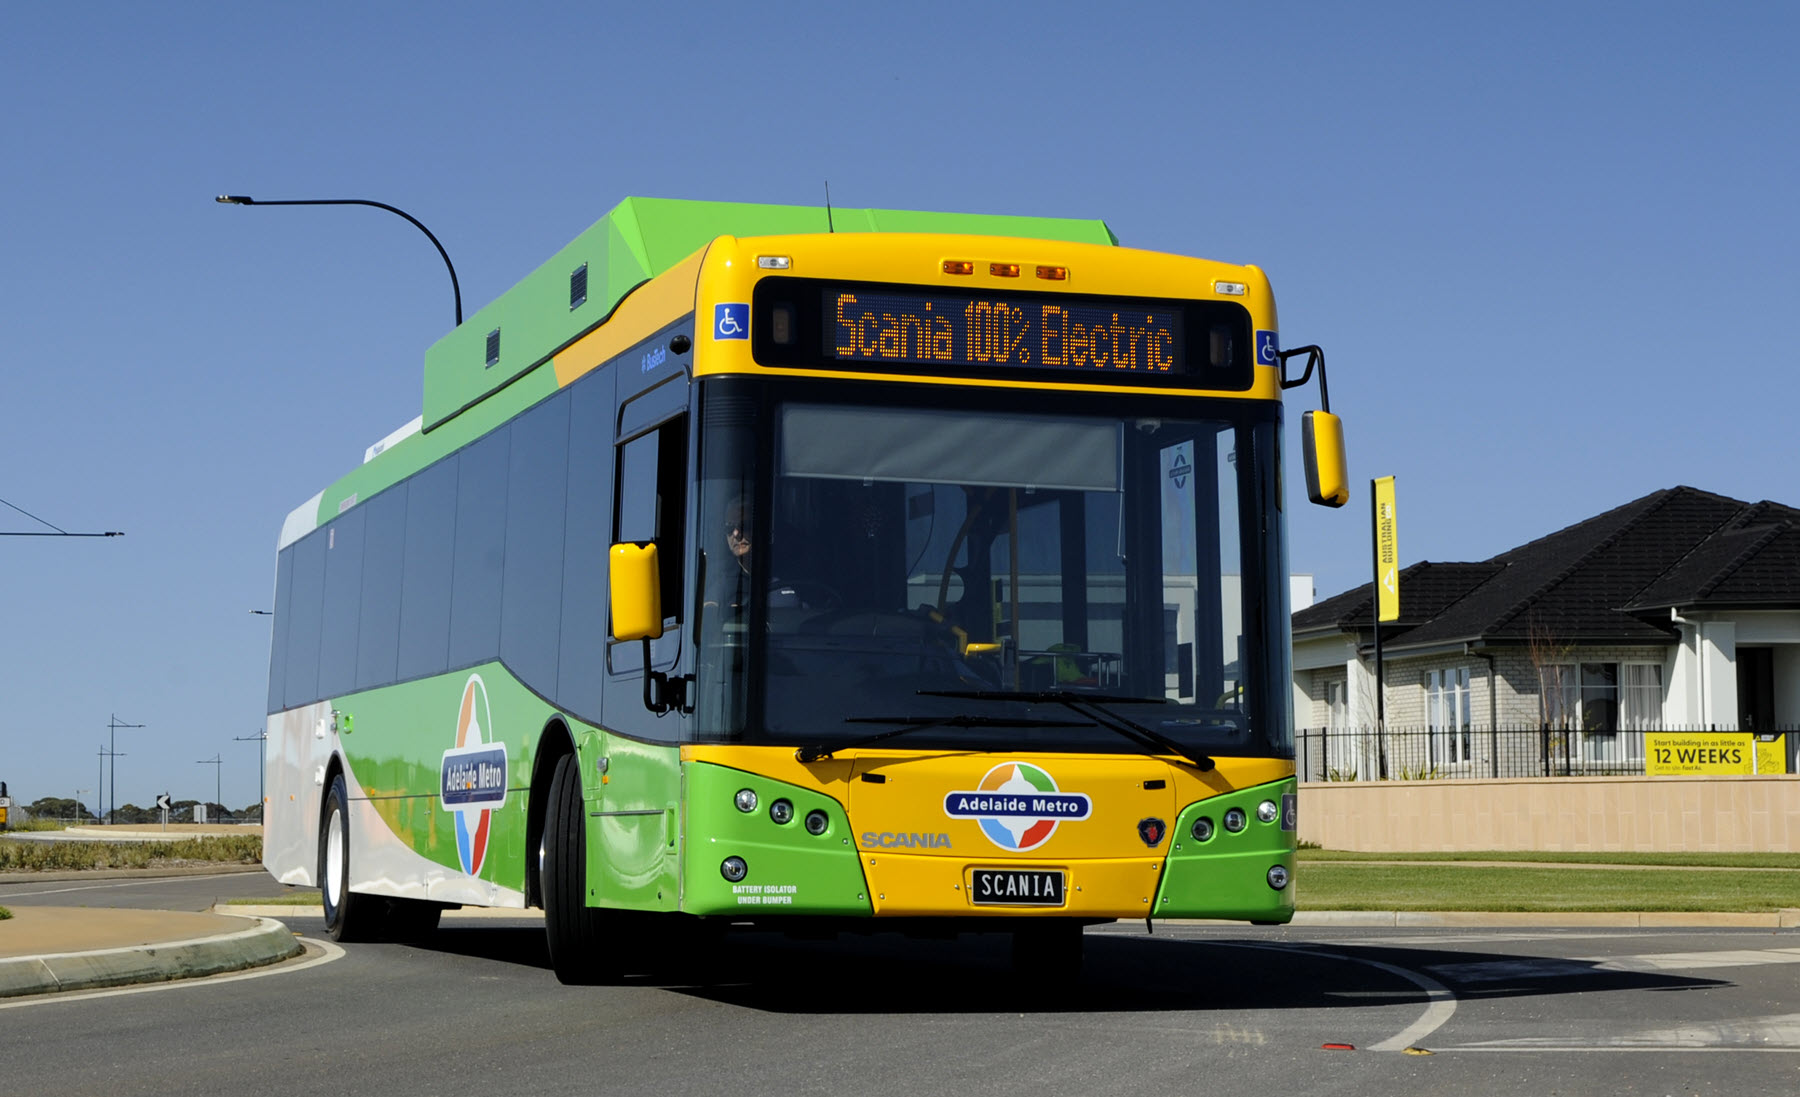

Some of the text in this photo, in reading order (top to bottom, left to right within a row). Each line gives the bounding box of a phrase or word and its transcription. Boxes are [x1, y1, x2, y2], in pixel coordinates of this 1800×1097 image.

[837, 294, 1173, 370] Scania 100% Electric
[1673, 739, 1701, 748] building
[1654, 749, 1742, 764] 12 WEEKS
[447, 762, 501, 791] Adelaide Metro
[958, 797, 1079, 813] Adelaide Metro
[861, 832, 953, 849] SCANIA
[732, 885, 797, 894] BATTERY ISOLATOR
[981, 873, 1055, 897] SCANIA
[737, 896, 792, 905] UNDER BUMPER
